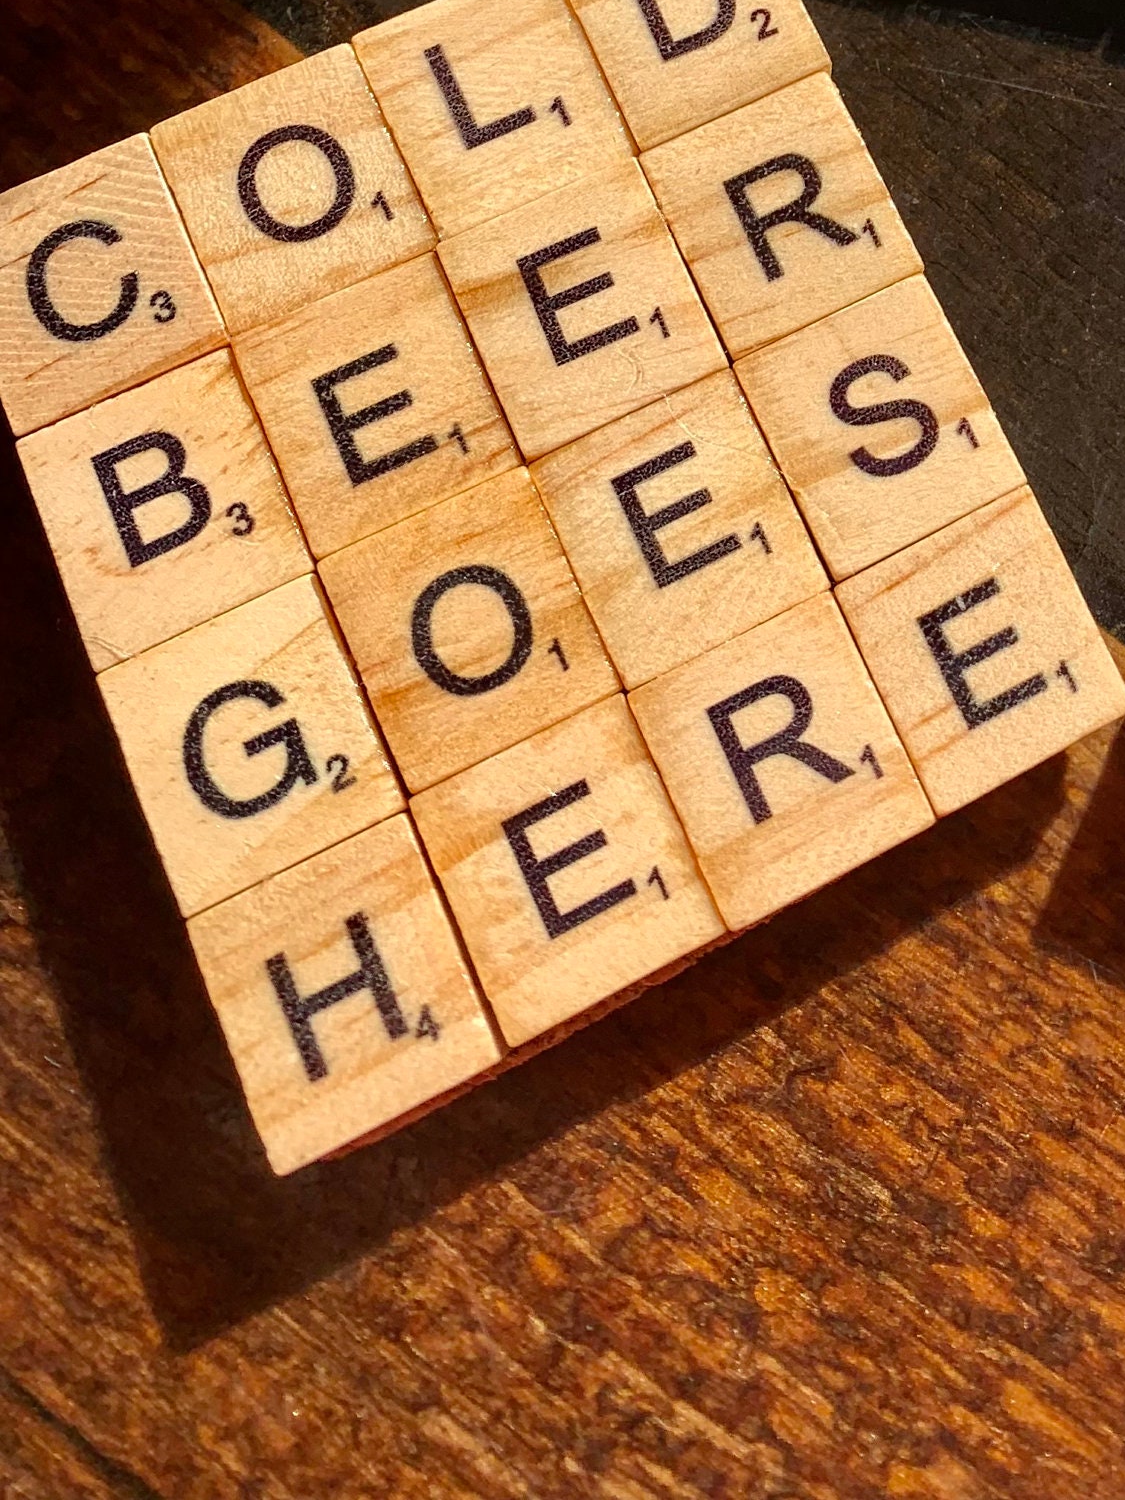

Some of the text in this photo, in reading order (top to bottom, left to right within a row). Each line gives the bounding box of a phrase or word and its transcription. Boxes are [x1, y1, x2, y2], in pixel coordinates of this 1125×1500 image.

[749, 8, 780, 42] 2
[547, 95, 573, 128] 1
[369, 189, 396, 222] 1
[861, 217, 883, 249] 1
[148, 289, 178, 325] 3
[648, 305, 671, 340] 1
[88, 151, 863, 570] BEER
[445, 421, 472, 457] 1
[954, 416, 981, 450] 1
[224, 501, 257, 537] 3
[748, 521, 774, 556] 1
[180, 352, 941, 821] GOES
[547, 636, 570, 673] 1
[1054, 658, 1079, 694] 1
[325, 753, 358, 795] 2
[858, 743, 885, 780] 1
[264, 575, 1049, 1082] HERE
[646, 865, 671, 901] 1
[414, 1003, 442, 1042] 4
